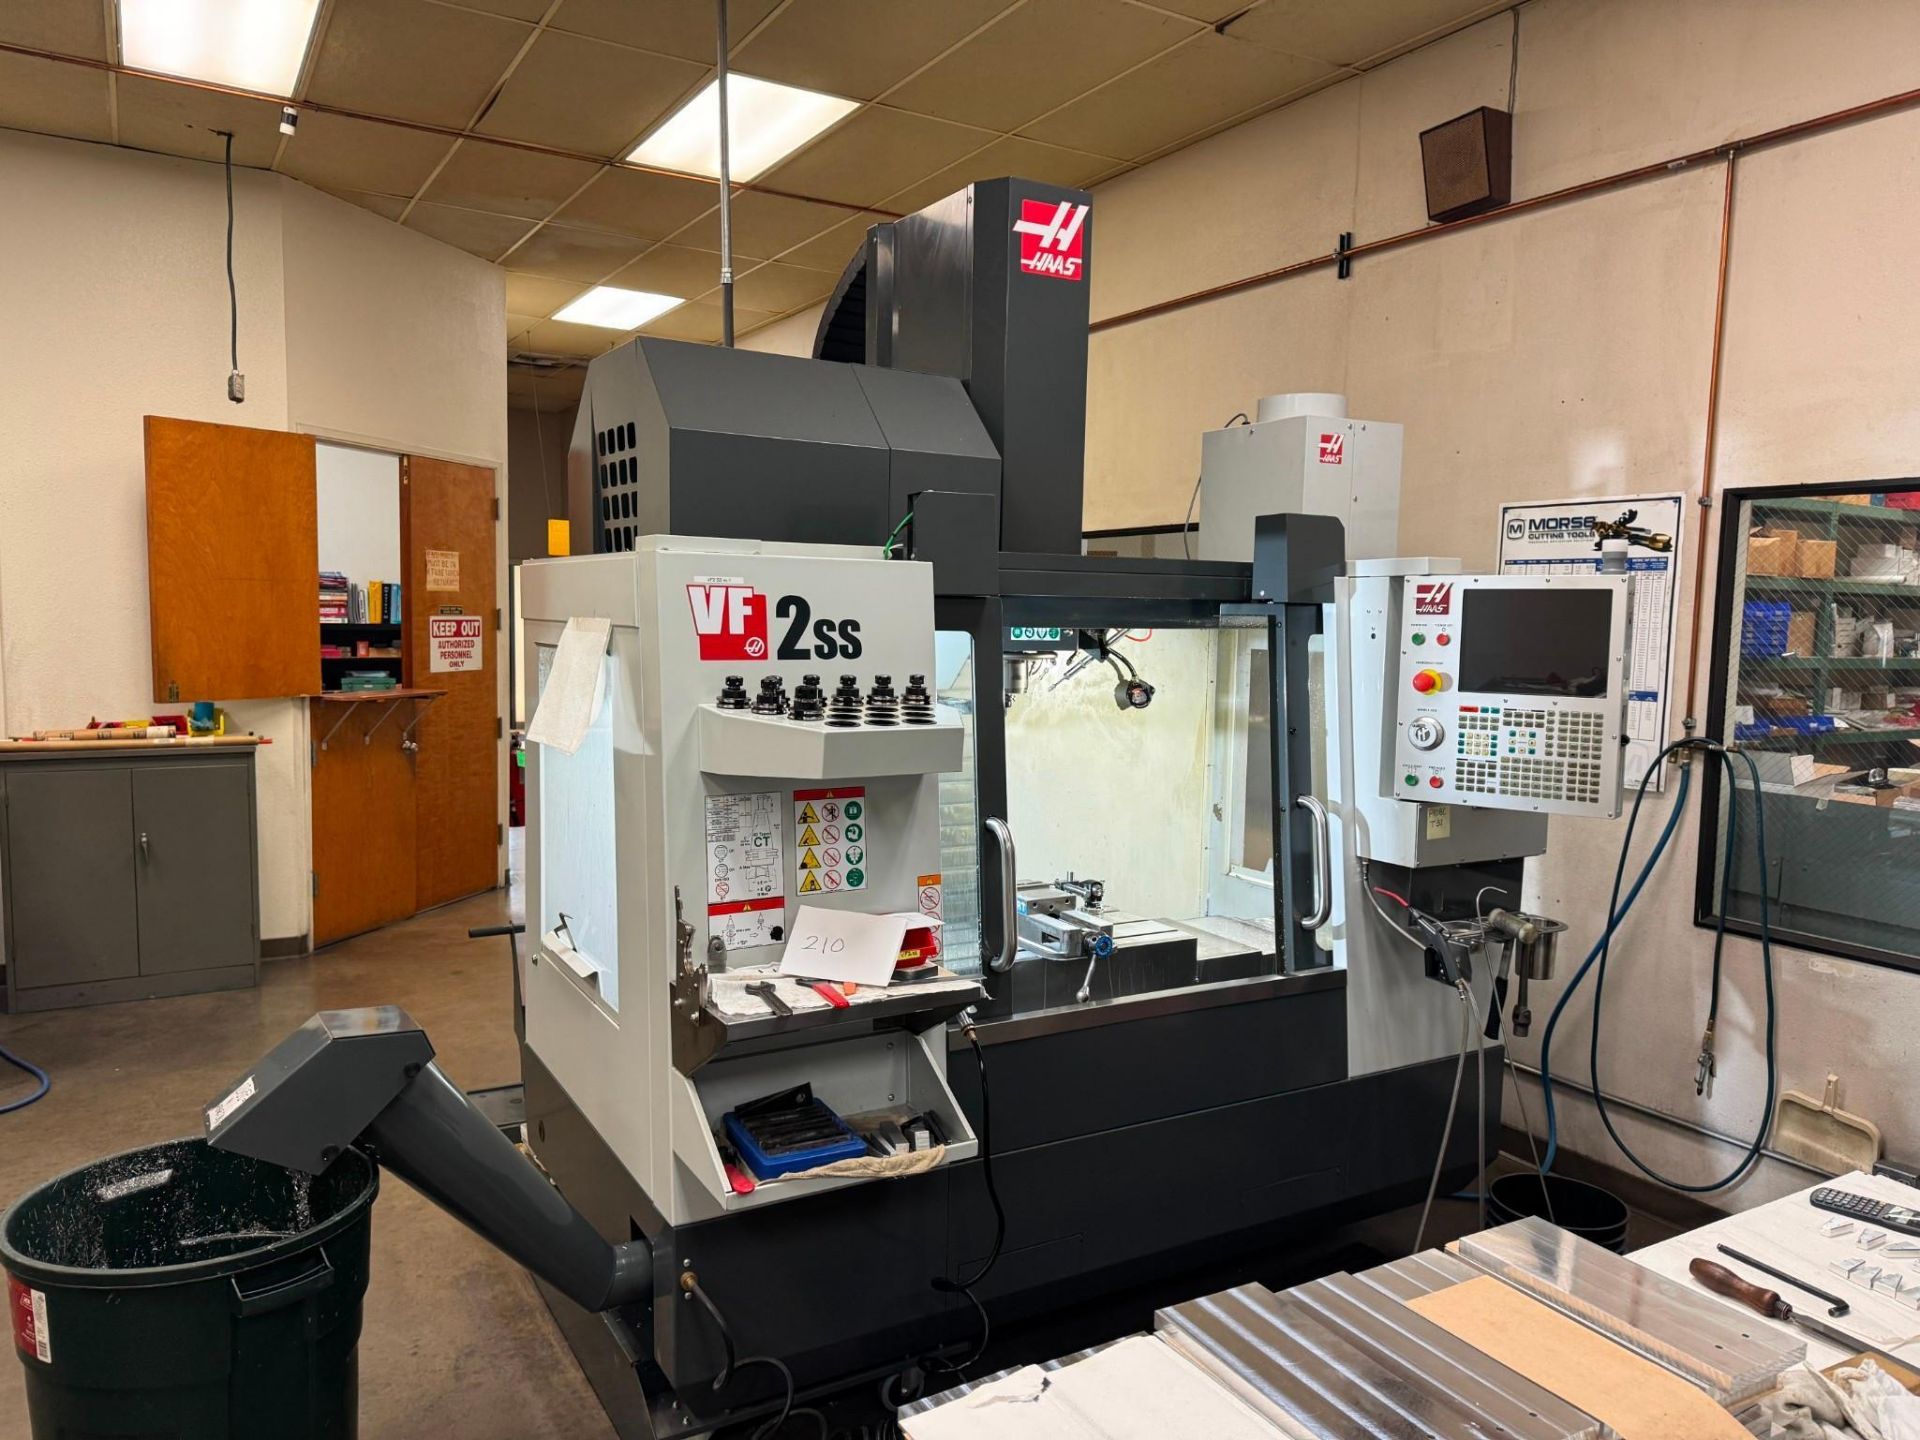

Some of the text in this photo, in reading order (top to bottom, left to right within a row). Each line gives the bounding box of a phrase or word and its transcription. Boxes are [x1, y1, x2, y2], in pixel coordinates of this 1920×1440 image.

[1021, 251, 1082, 276] HAAS
[1528, 516, 1597, 530] MORSE
[1528, 531, 1595, 540] CUTTING TOOLS
[686, 585, 754, 636] VF
[1416, 604, 1448, 614] HAAS
[432, 621, 480, 636] KEEP OUT
[438, 639, 475, 649] AUTHORIZED
[440, 650, 473, 660] PERSONNEL
[449, 660, 464, 668] ONLY
[754, 836, 770, 847] CT
[801, 935, 845, 954] 210
